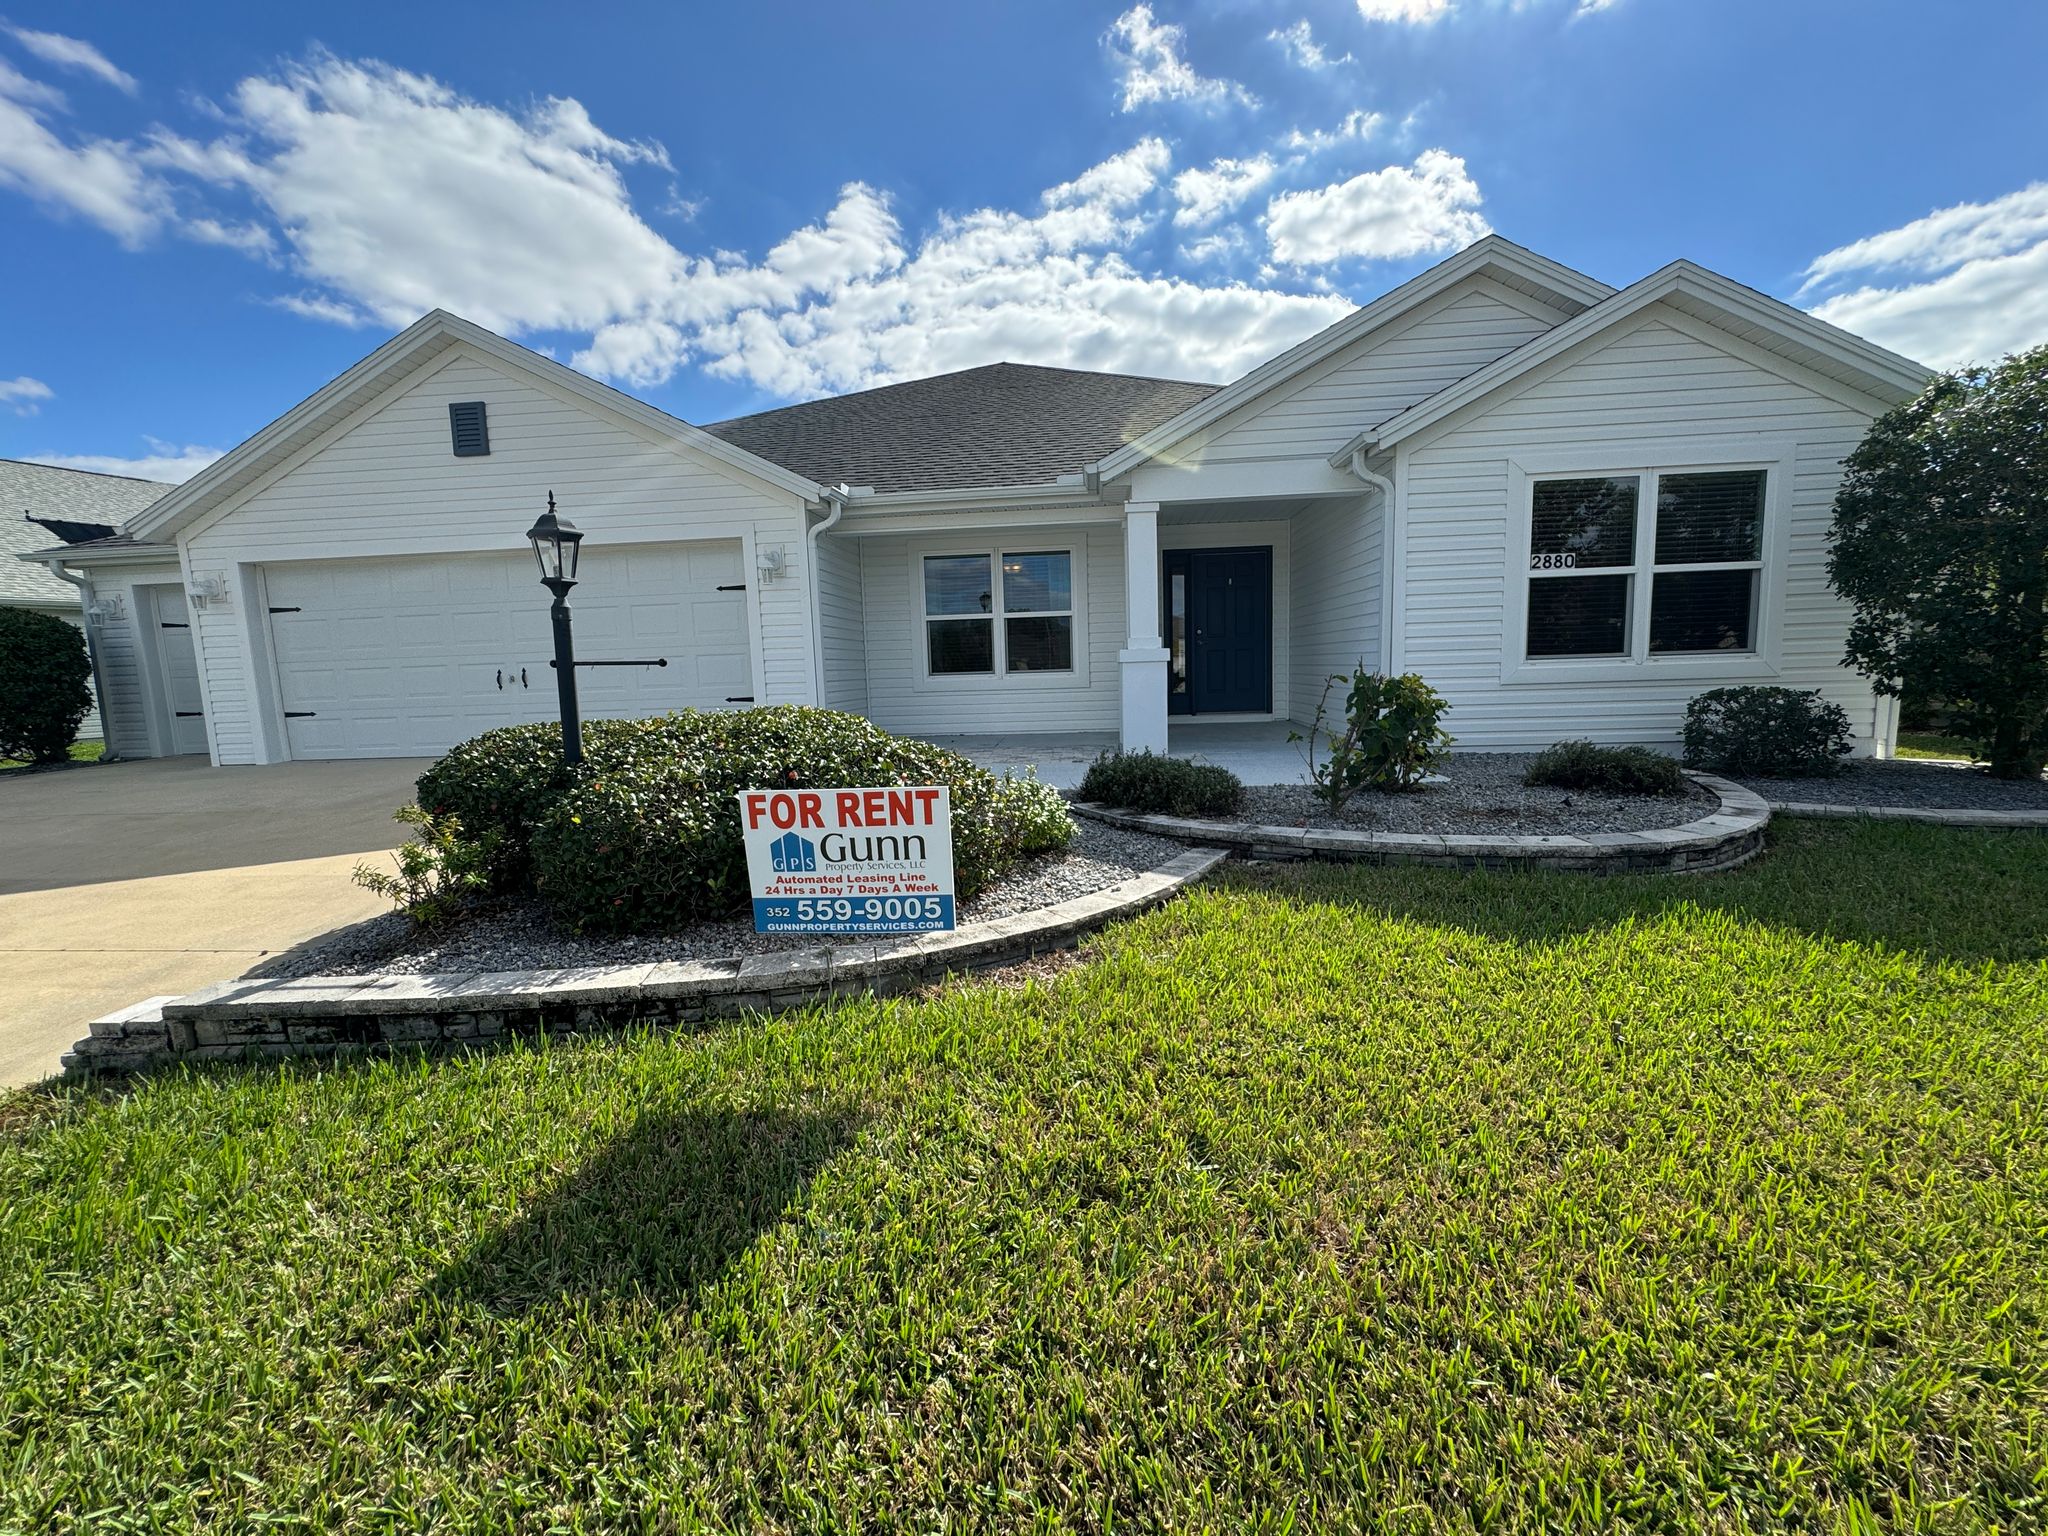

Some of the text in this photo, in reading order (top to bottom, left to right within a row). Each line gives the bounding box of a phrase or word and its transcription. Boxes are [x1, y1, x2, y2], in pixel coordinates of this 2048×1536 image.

[1531, 554, 1575, 569] 2880
[747, 790, 939, 829] FOR RENT
[820, 833, 926, 862] Gunn
[773, 859, 814, 870] GPS
[825, 863, 864, 873] Property
[867, 862, 906, 870] Services,
[776, 873, 926, 884] Automated Leasing Line
[765, 886, 780, 895] 24
[784, 886, 805, 894] Hrs
[820, 886, 843, 896] Day
[848, 885, 853, 893] 7
[859, 885, 888, 894] Days
[892, 884, 901, 892] A
[905, 883, 939, 892] Week
[766, 898, 942, 921] 352 559-9005
[767, 921, 944, 931] GUNNPROPERTYSERVICES.COM
